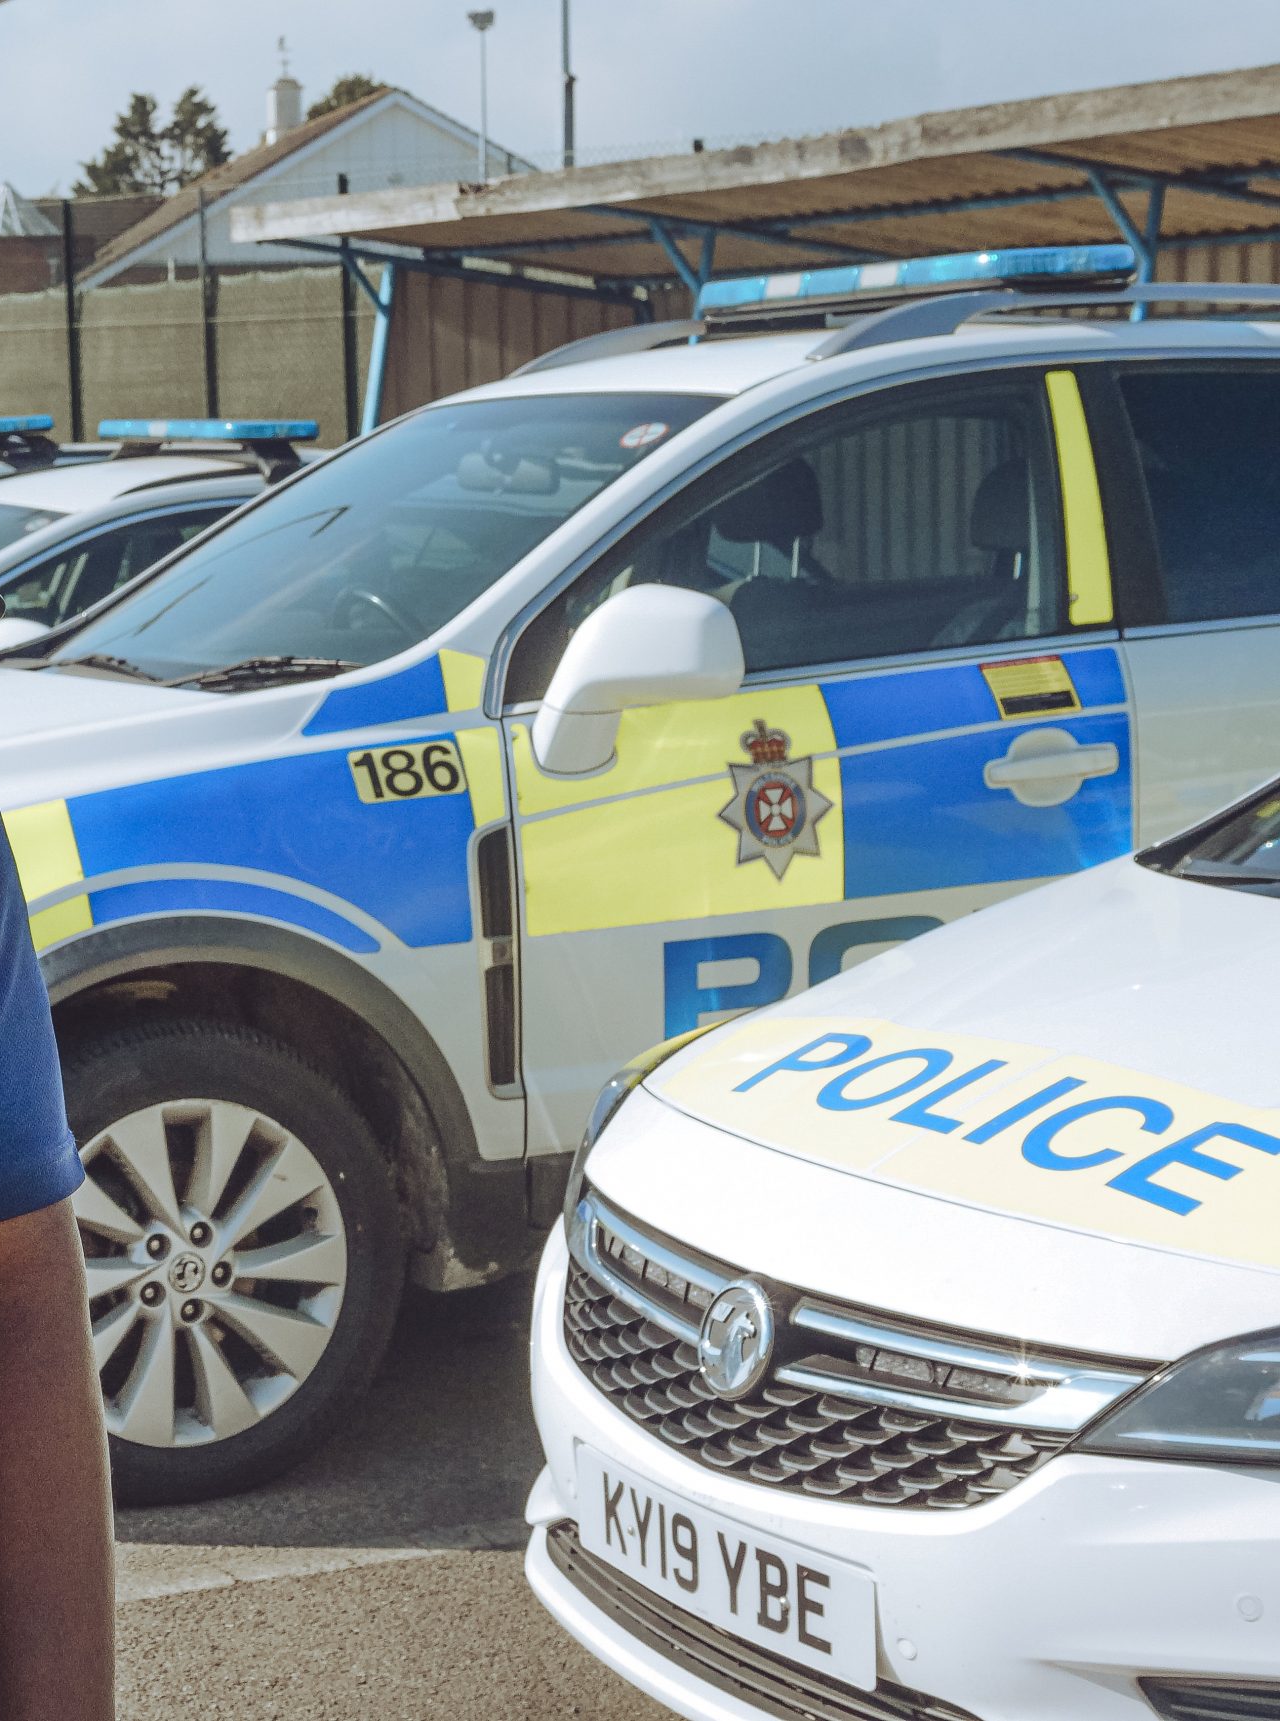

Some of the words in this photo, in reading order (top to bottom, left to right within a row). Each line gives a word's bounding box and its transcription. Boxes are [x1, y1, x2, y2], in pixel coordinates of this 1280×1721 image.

[354, 745, 460, 798] 186
[731, 1031, 1280, 1217] POLICE
[602, 1471, 700, 1594] KY19
[717, 1530, 833, 1656] YBE
